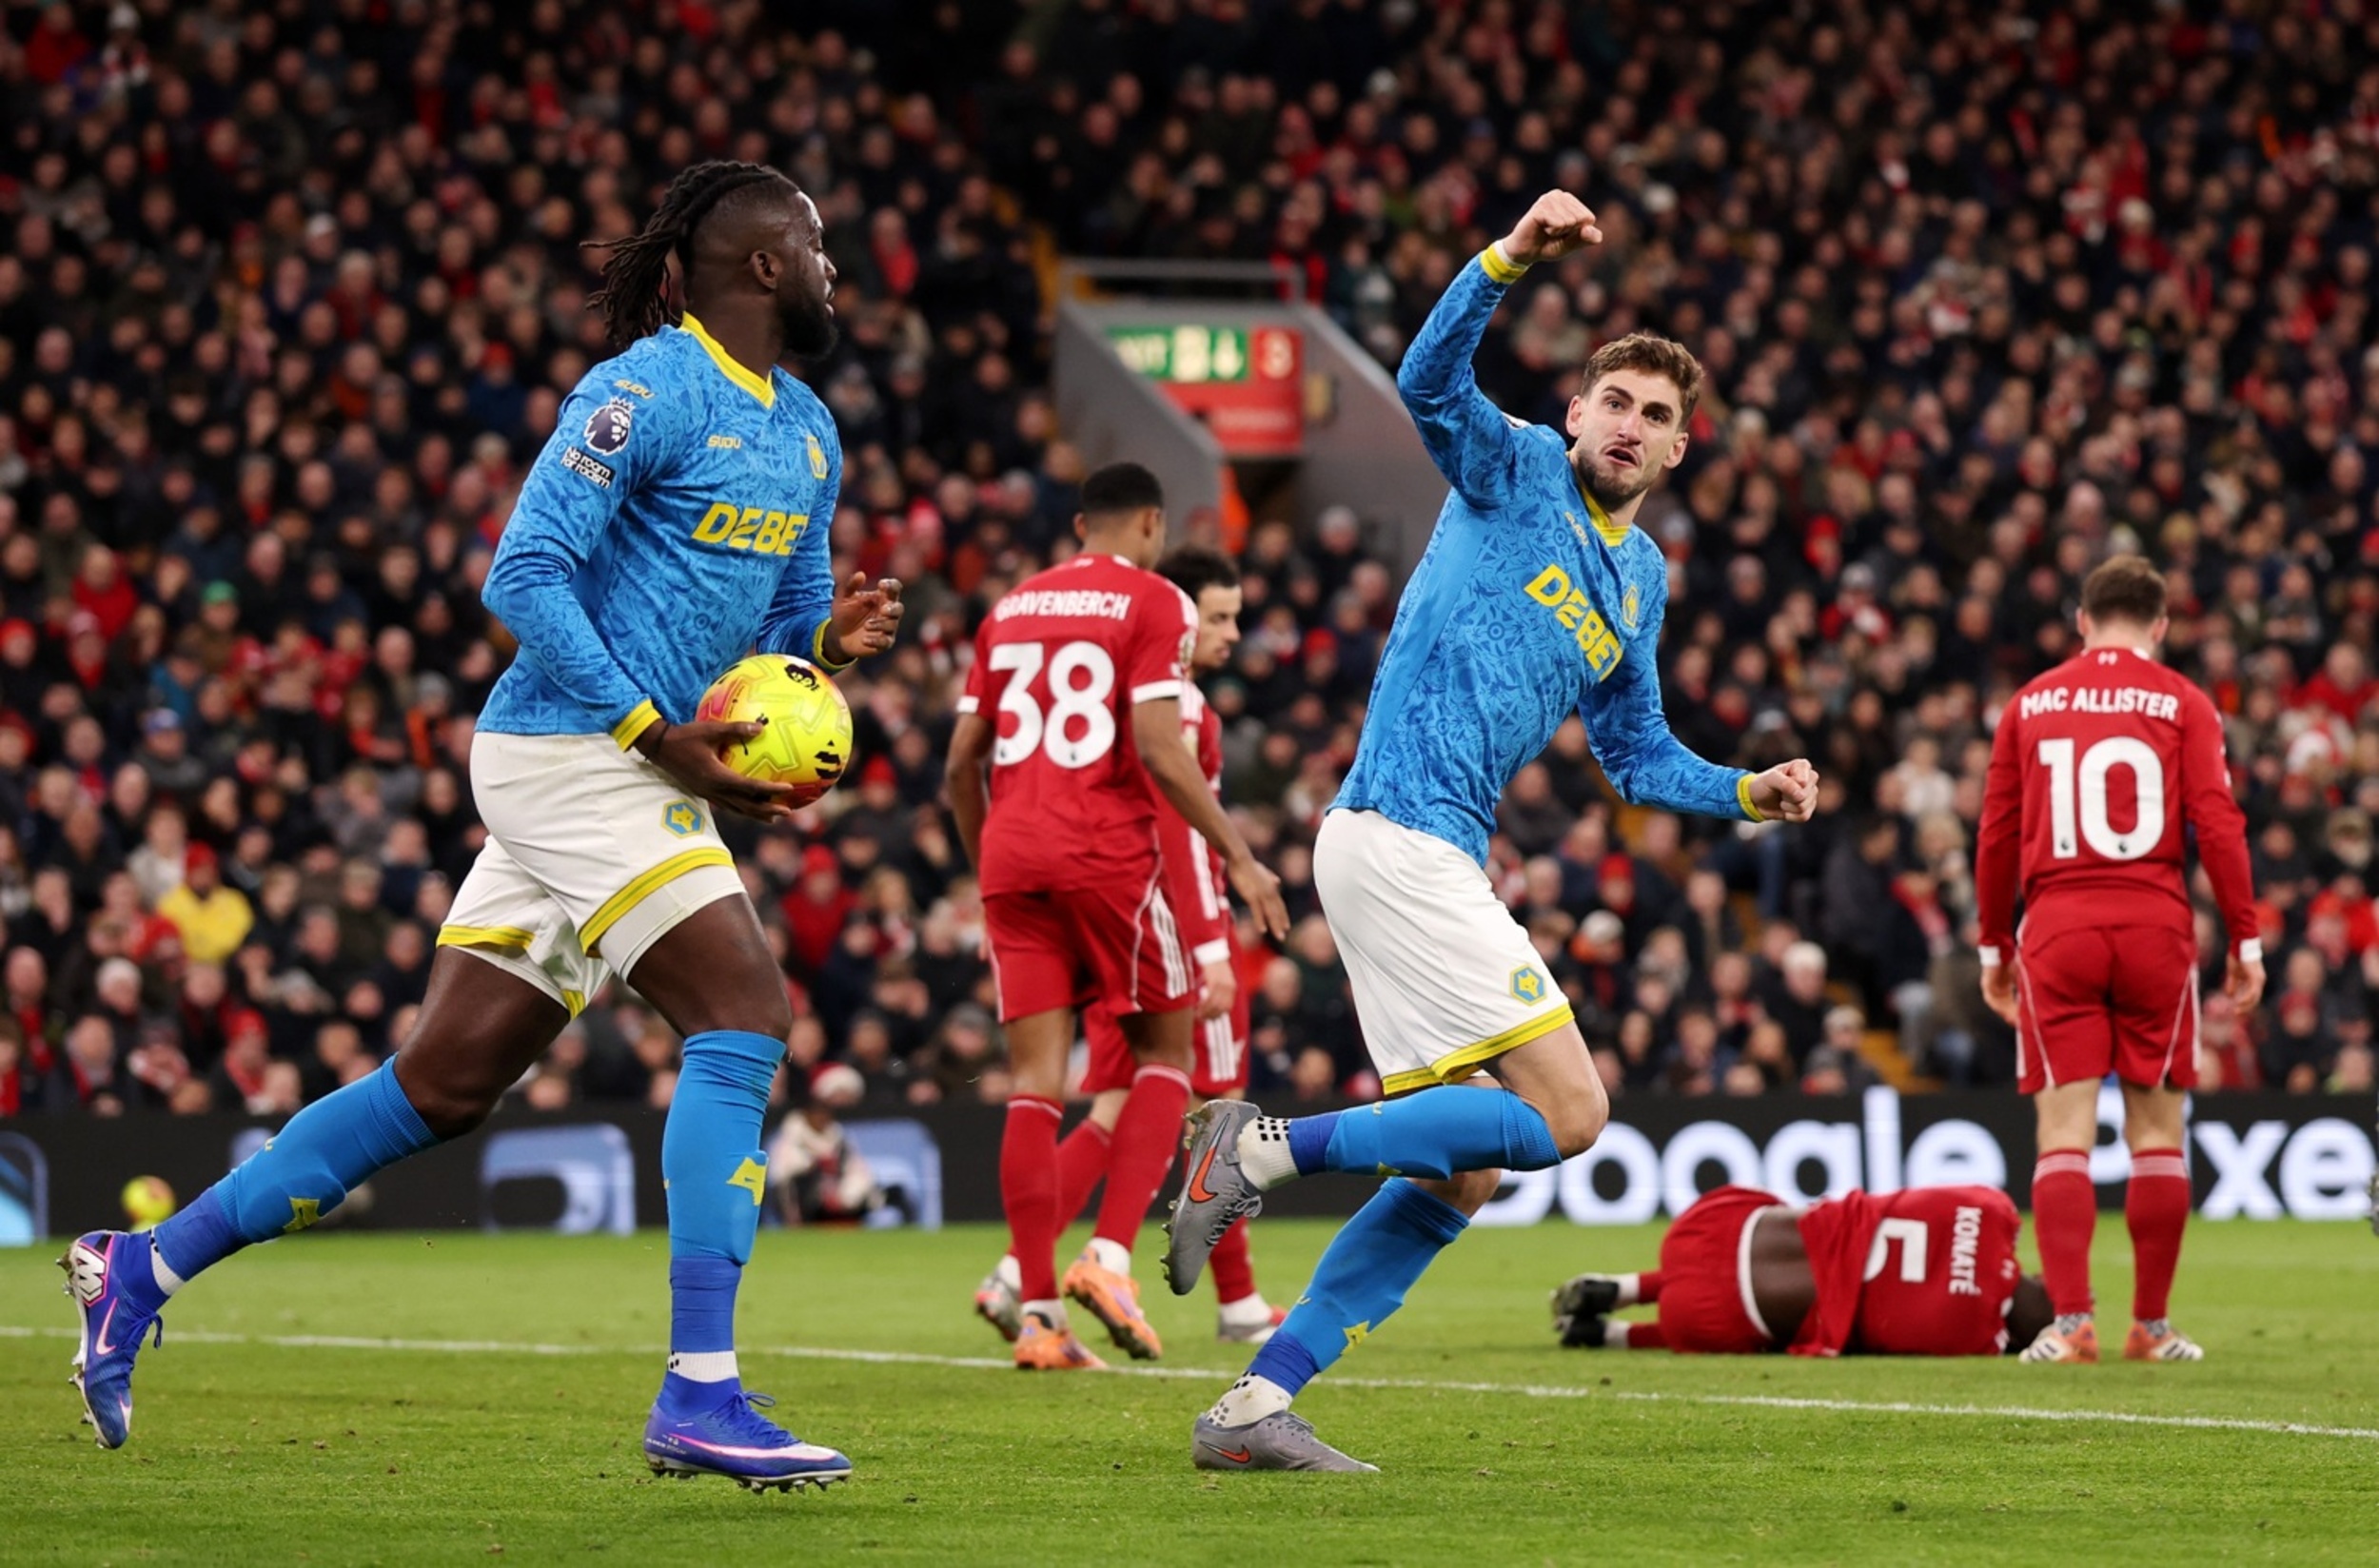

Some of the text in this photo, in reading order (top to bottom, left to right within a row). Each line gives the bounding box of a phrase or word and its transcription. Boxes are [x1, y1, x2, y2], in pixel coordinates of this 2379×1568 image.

[560, 456, 610, 489] for racism
[564, 447, 611, 478] No room
[691, 502, 808, 556] DEBE
[994, 590, 1131, 621] GRAVENBERCH
[989, 640, 1115, 769] 38
[2020, 687, 2178, 721] MAC ALLISTER
[2037, 735, 2165, 861] 10
[1949, 1205, 1982, 1296] KONATÉ
